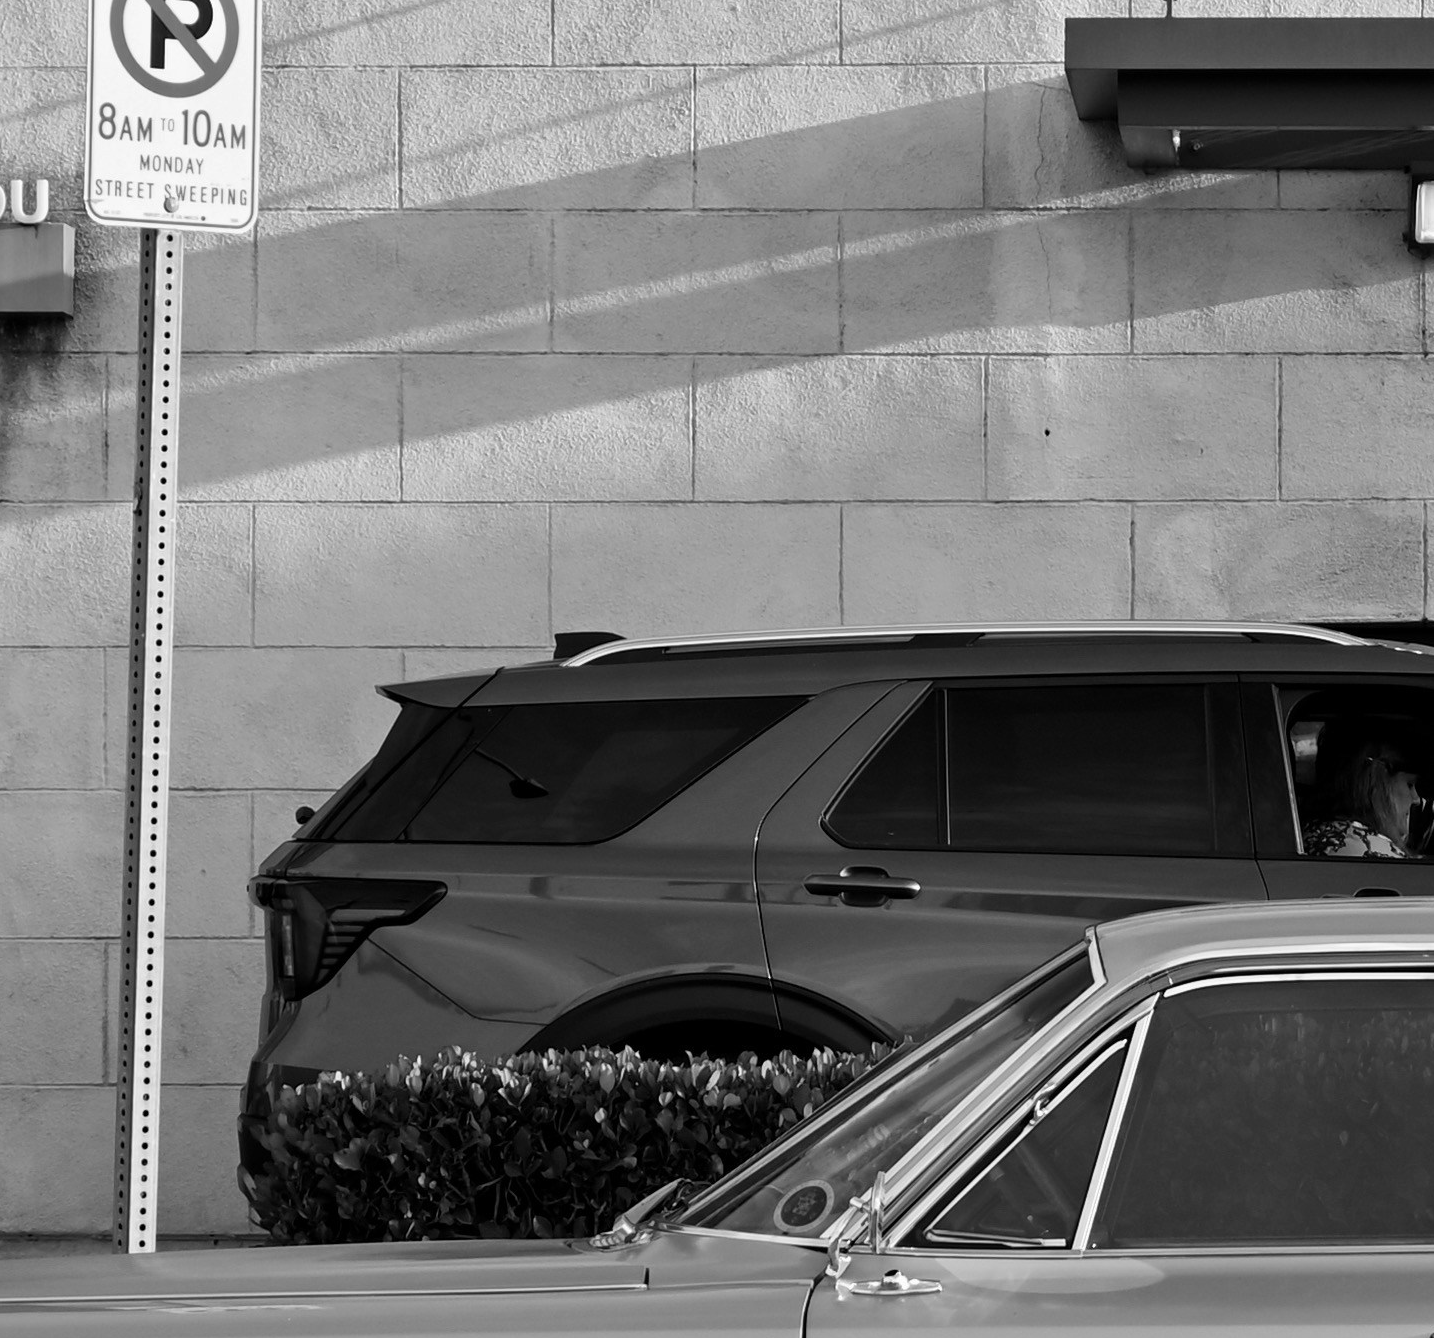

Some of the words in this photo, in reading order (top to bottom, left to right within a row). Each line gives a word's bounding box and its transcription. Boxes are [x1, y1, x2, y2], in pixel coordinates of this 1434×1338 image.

[98, 102, 153, 143] 8AM
[161, 118, 175, 132] TO
[181, 109, 247, 150] 10AM
[139, 154, 205, 175] MONDAY
[95, 179, 155, 199] STREET
[164, 184, 248, 206] SWEEPING
